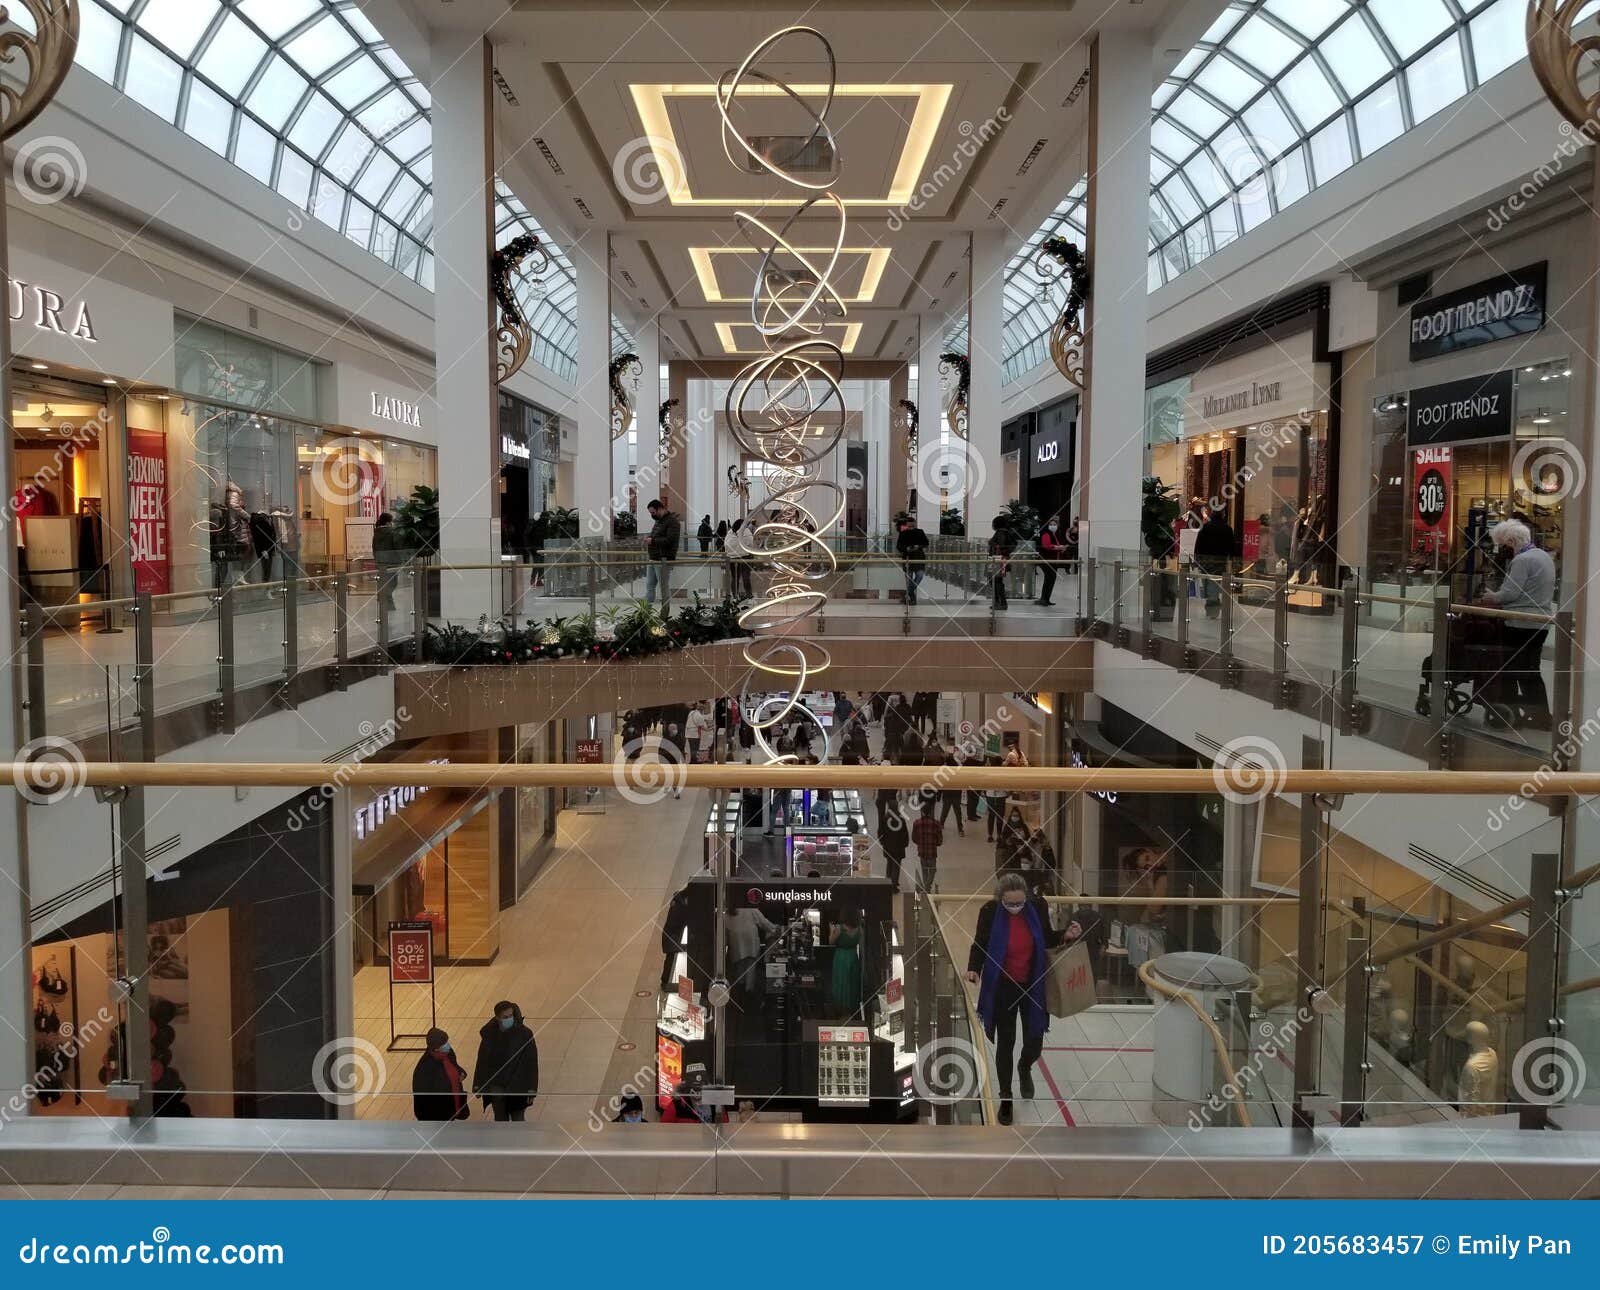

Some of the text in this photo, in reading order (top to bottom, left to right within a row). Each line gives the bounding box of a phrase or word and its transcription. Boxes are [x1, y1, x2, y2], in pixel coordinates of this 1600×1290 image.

[1412, 284, 1527, 342] FOOT TRENDZ
[371, 392, 422, 427] LAURA
[1417, 394, 1499, 426] FOOT TRENDZ
[1037, 441, 1057, 463] ALDO
[1416, 447, 1450, 464] SALE
[130, 522, 166, 561] SALE
[1243, 534, 1260, 546] SALE
[578, 745, 599, 753] SALE
[765, 889, 832, 904] sunglass hut
[397, 944, 424, 954] 50%
[398, 955, 424, 964] OFF
